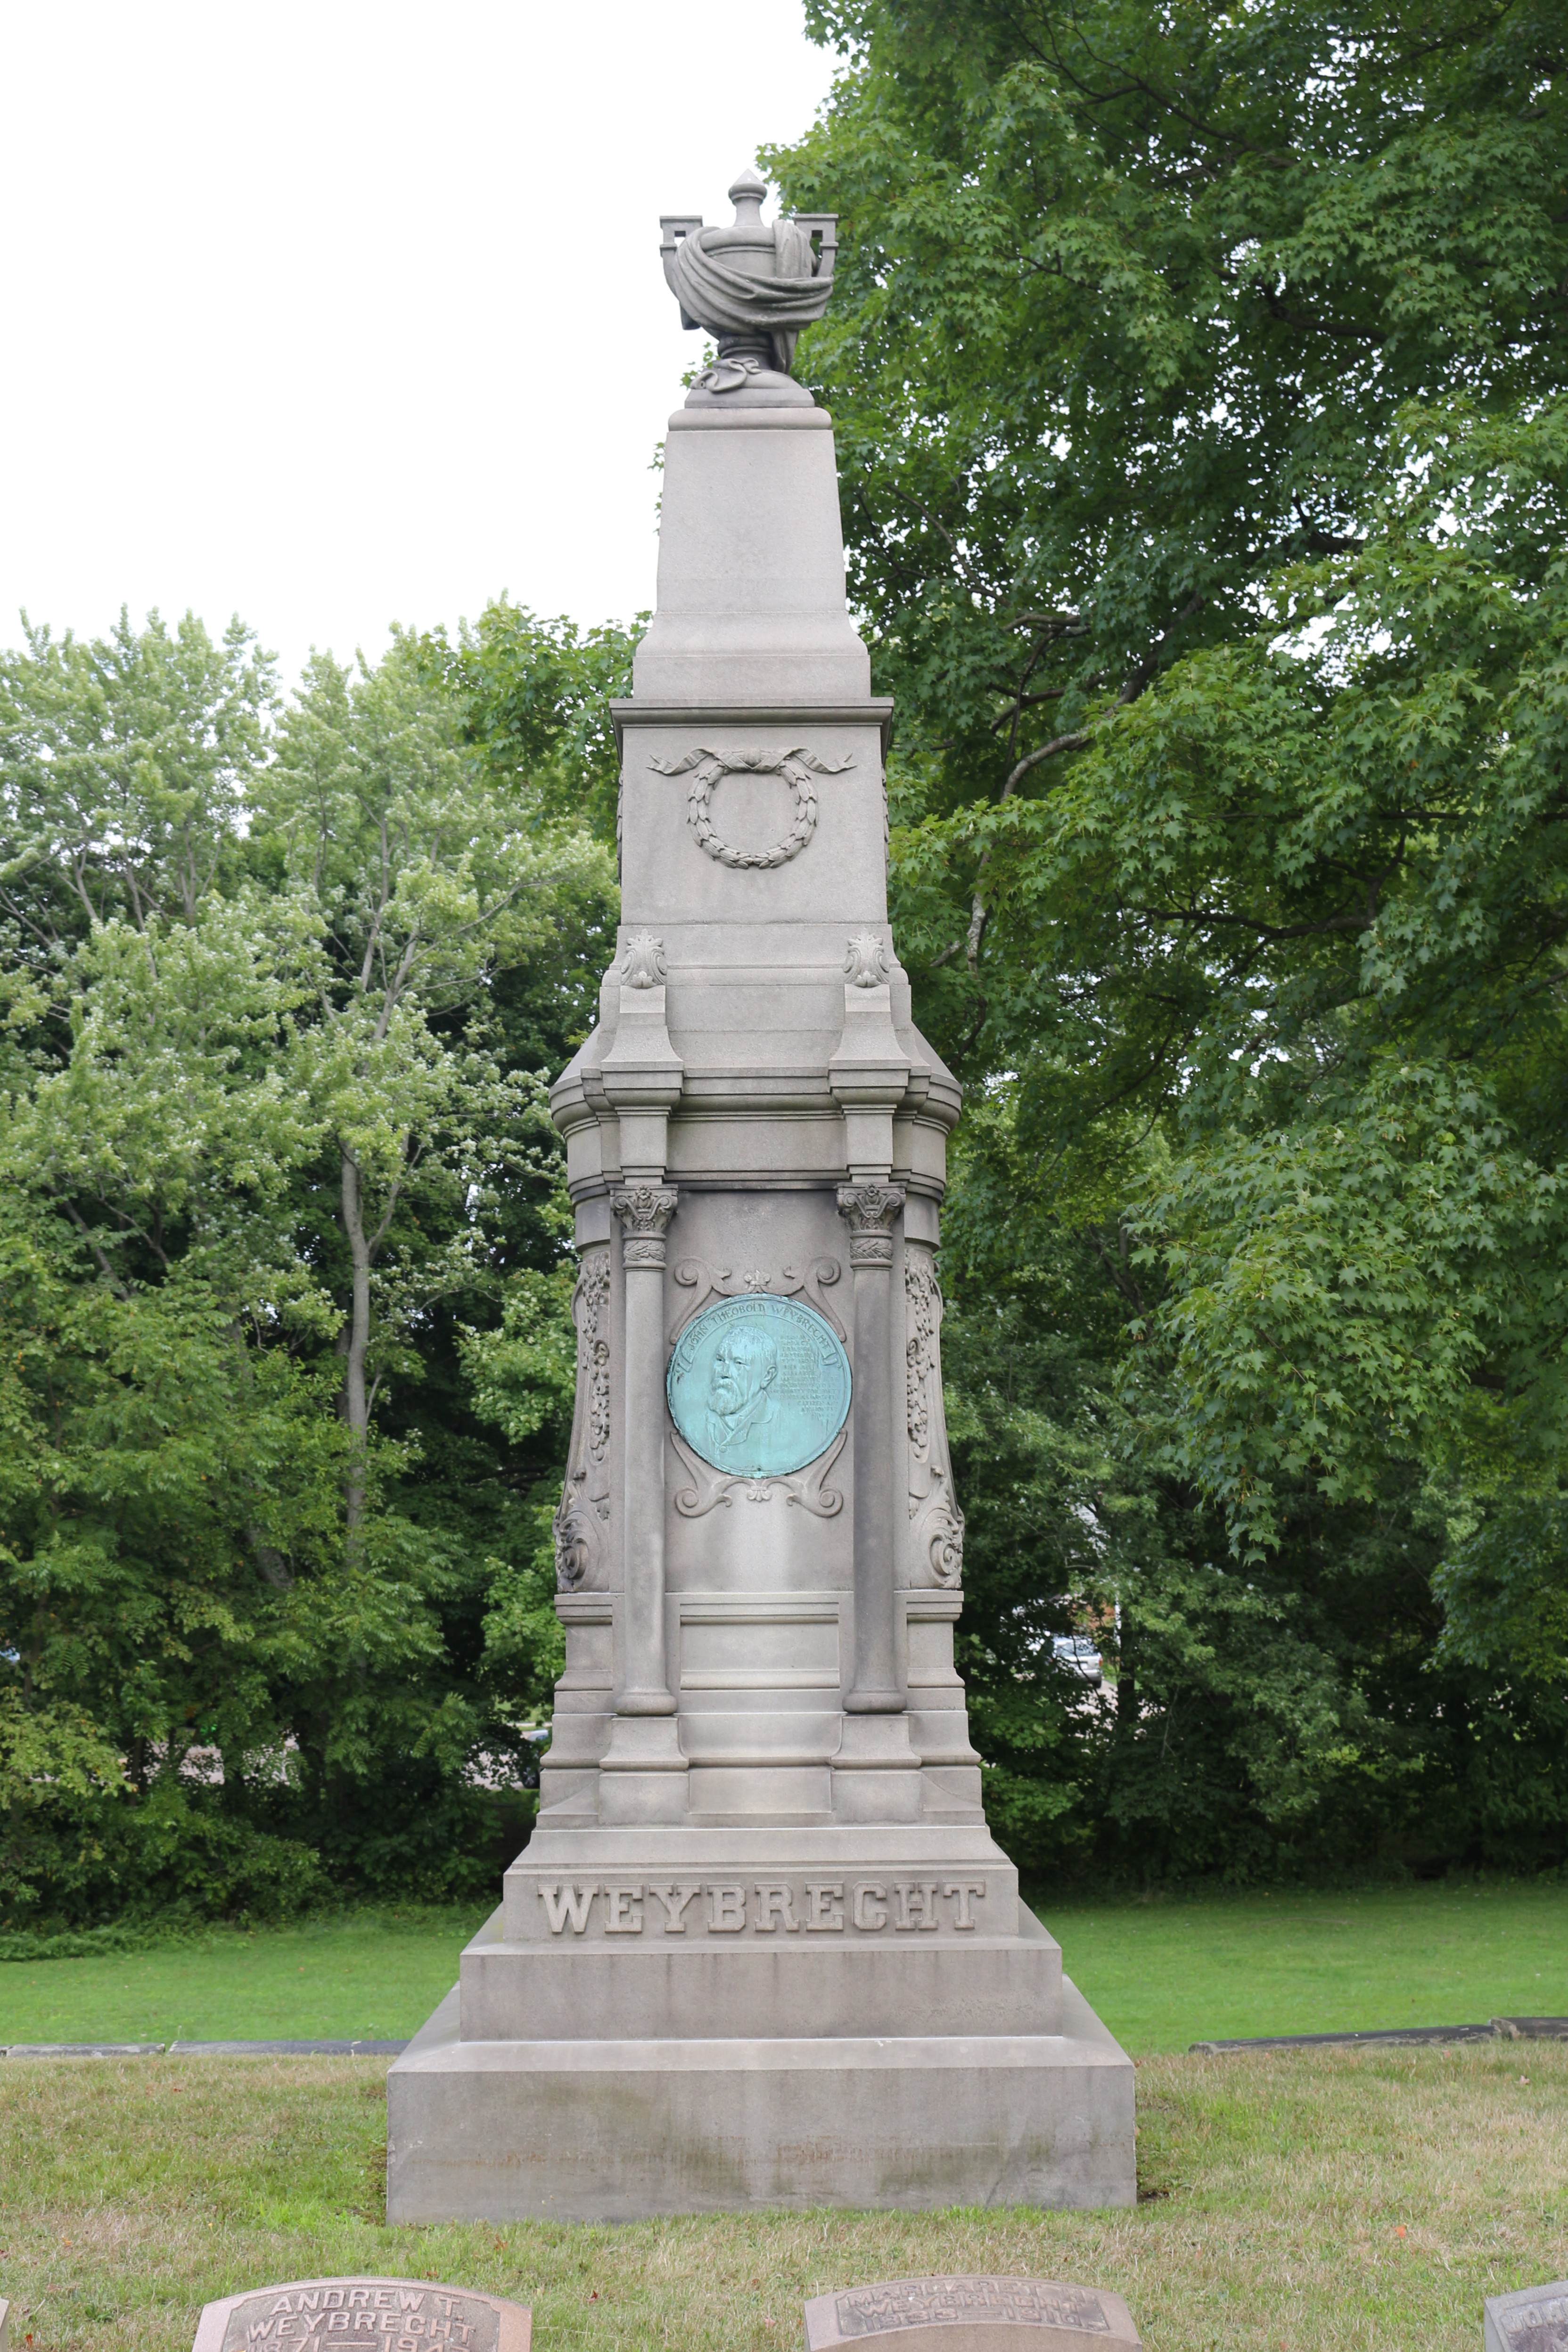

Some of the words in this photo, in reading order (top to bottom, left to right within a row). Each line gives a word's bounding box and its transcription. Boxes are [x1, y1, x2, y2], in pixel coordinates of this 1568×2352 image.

[688, 1324, 707, 1351] JOHN
[771, 1304, 832, 1350] WEYBRECHT
[537, 1880, 986, 1934] WEYBRECHT
[269, 2289, 425, 2316] ANDREW
[438, 2296, 464, 2320] T.
[847, 2279, 1042, 2308] MARGARET
[854, 2293, 1084, 2318] WEYBRECHT
[248, 2311, 477, 2344] WEYBRECHT
[1500, 2302, 1568, 2333] JOH
[383, 2336, 470, 2352] 19
